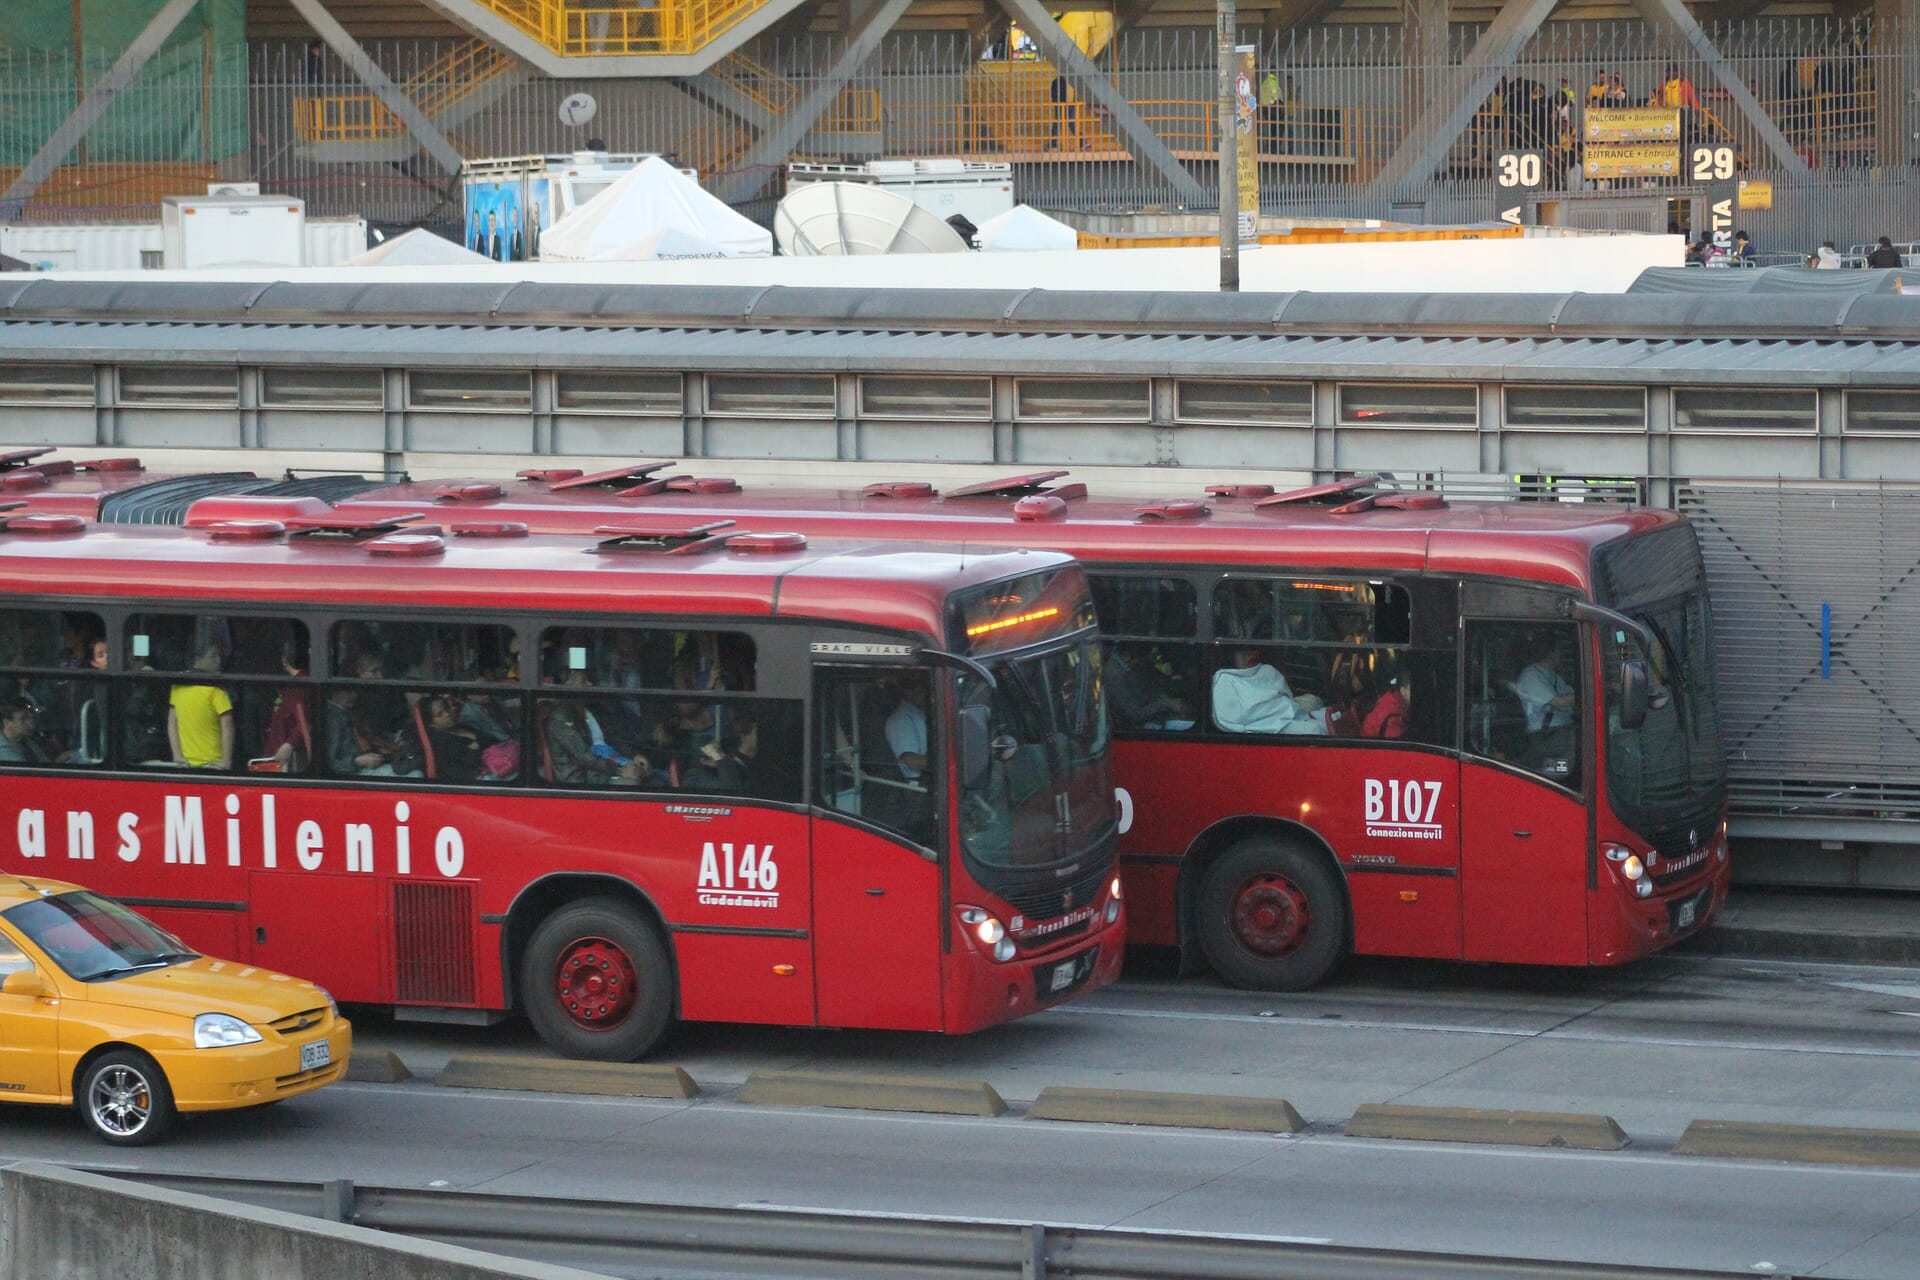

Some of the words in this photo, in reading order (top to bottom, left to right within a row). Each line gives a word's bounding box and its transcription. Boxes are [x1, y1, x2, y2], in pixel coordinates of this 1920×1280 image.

[1589, 114, 1626, 122] WELCOME
[1588, 150, 1634, 159] ENTRANCE
[1644, 148, 1675, 158] Entrada
[1693, 147, 1733, 180] 29
[1499, 154, 1540, 187] 30
[1712, 198, 1732, 248] RTA
[673, 805, 731, 815] Marcopolo
[1365, 779, 1442, 822] B107
[17, 793, 465, 878] ansMilenio
[697, 842, 778, 890] A146
[1352, 854, 1396, 863] VOLVO
